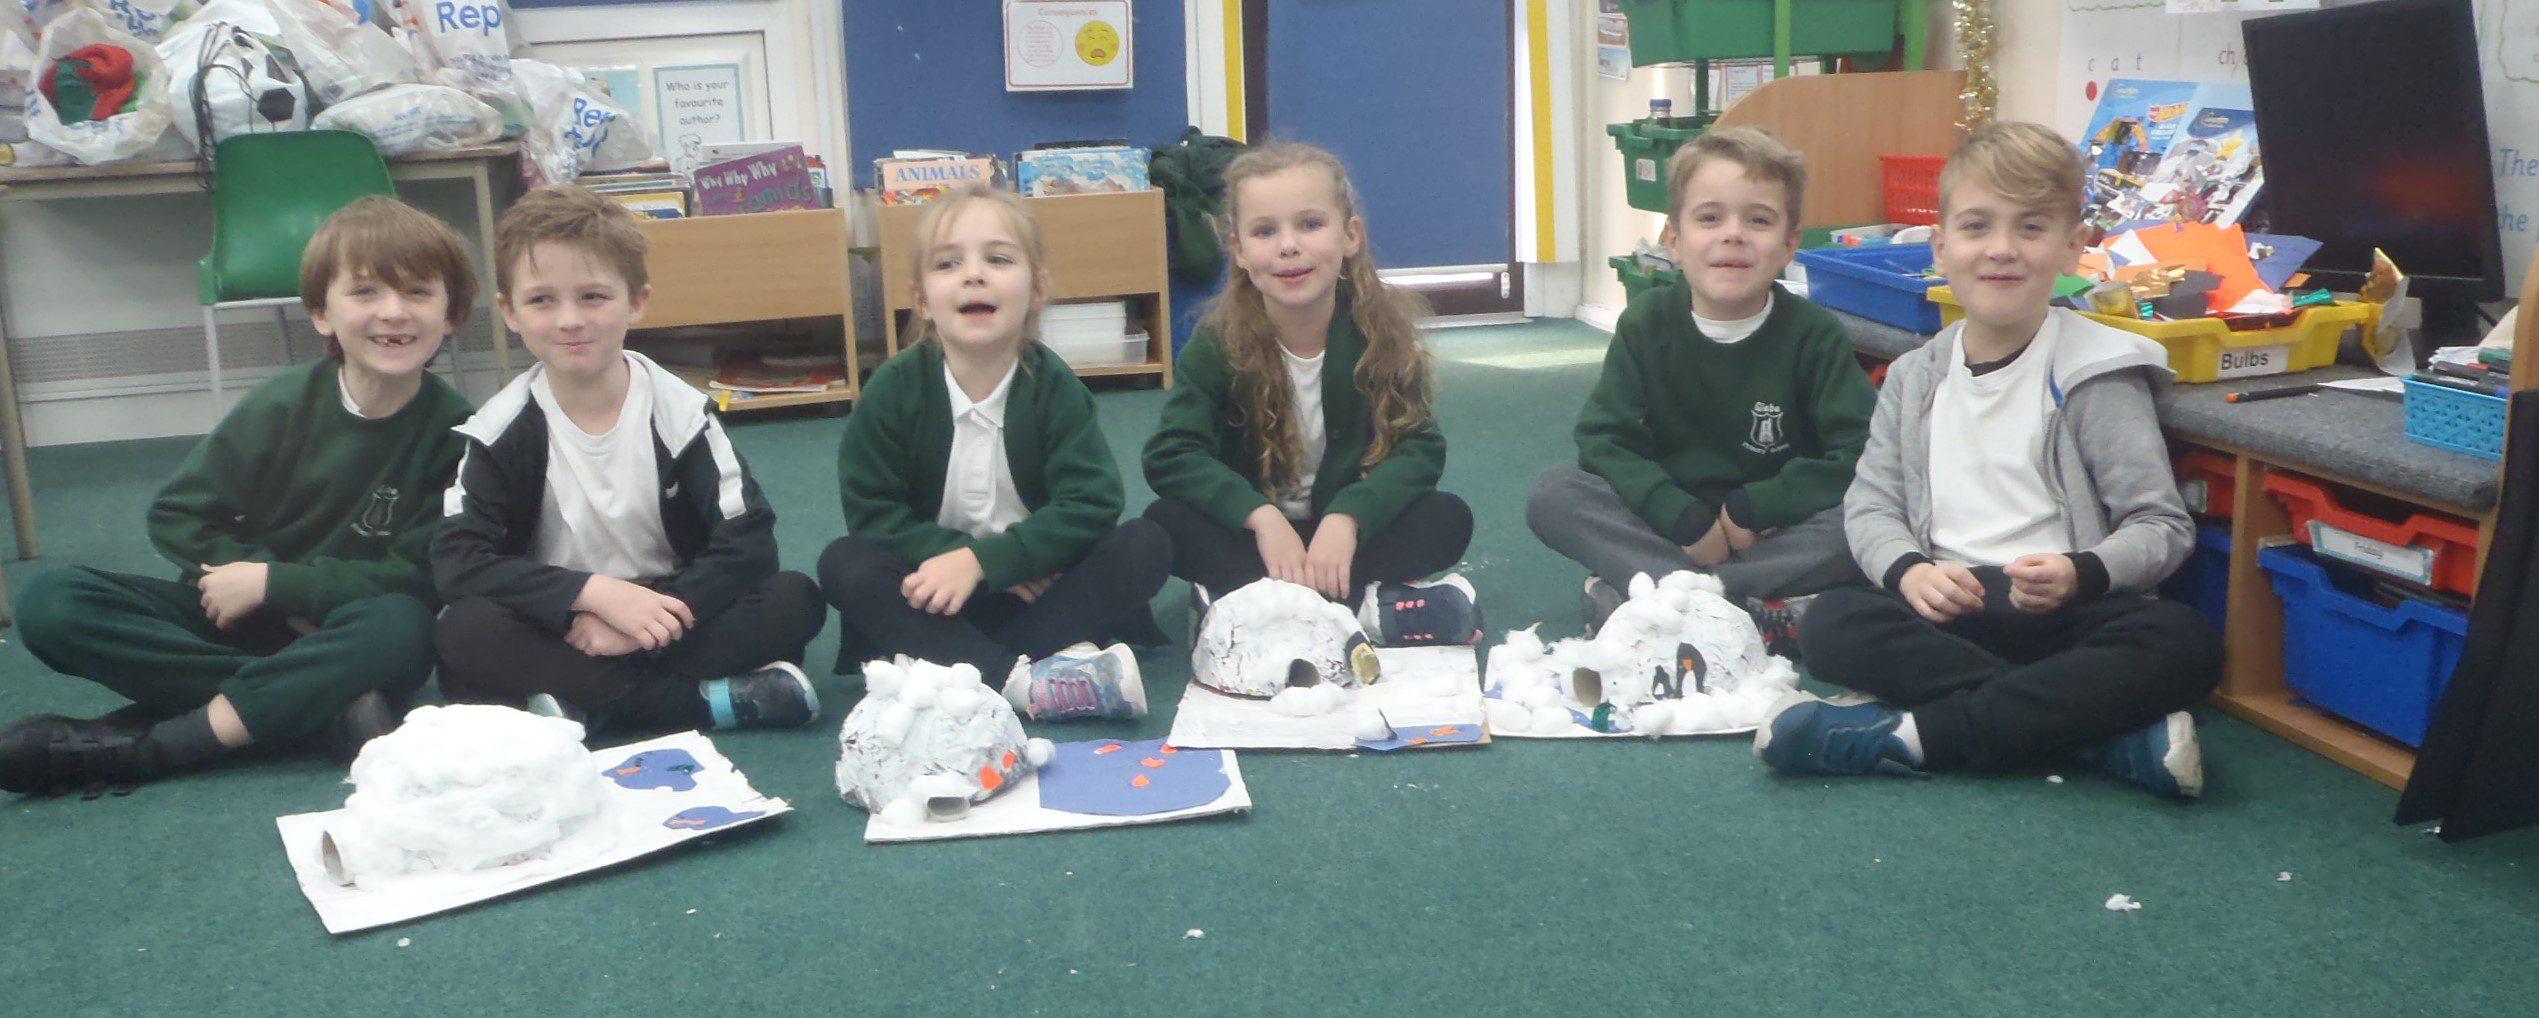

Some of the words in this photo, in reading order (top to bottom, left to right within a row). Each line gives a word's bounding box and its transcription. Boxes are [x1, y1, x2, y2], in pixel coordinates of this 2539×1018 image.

[665, 81, 690, 92] Who
[705, 80, 729, 94] your
[674, 97, 724, 109] favourite
[679, 113, 721, 126] author?
[2499, 148, 2539, 178] The
[896, 164, 981, 183] ANIMALS
[2221, 351, 2270, 370] Bulbs
